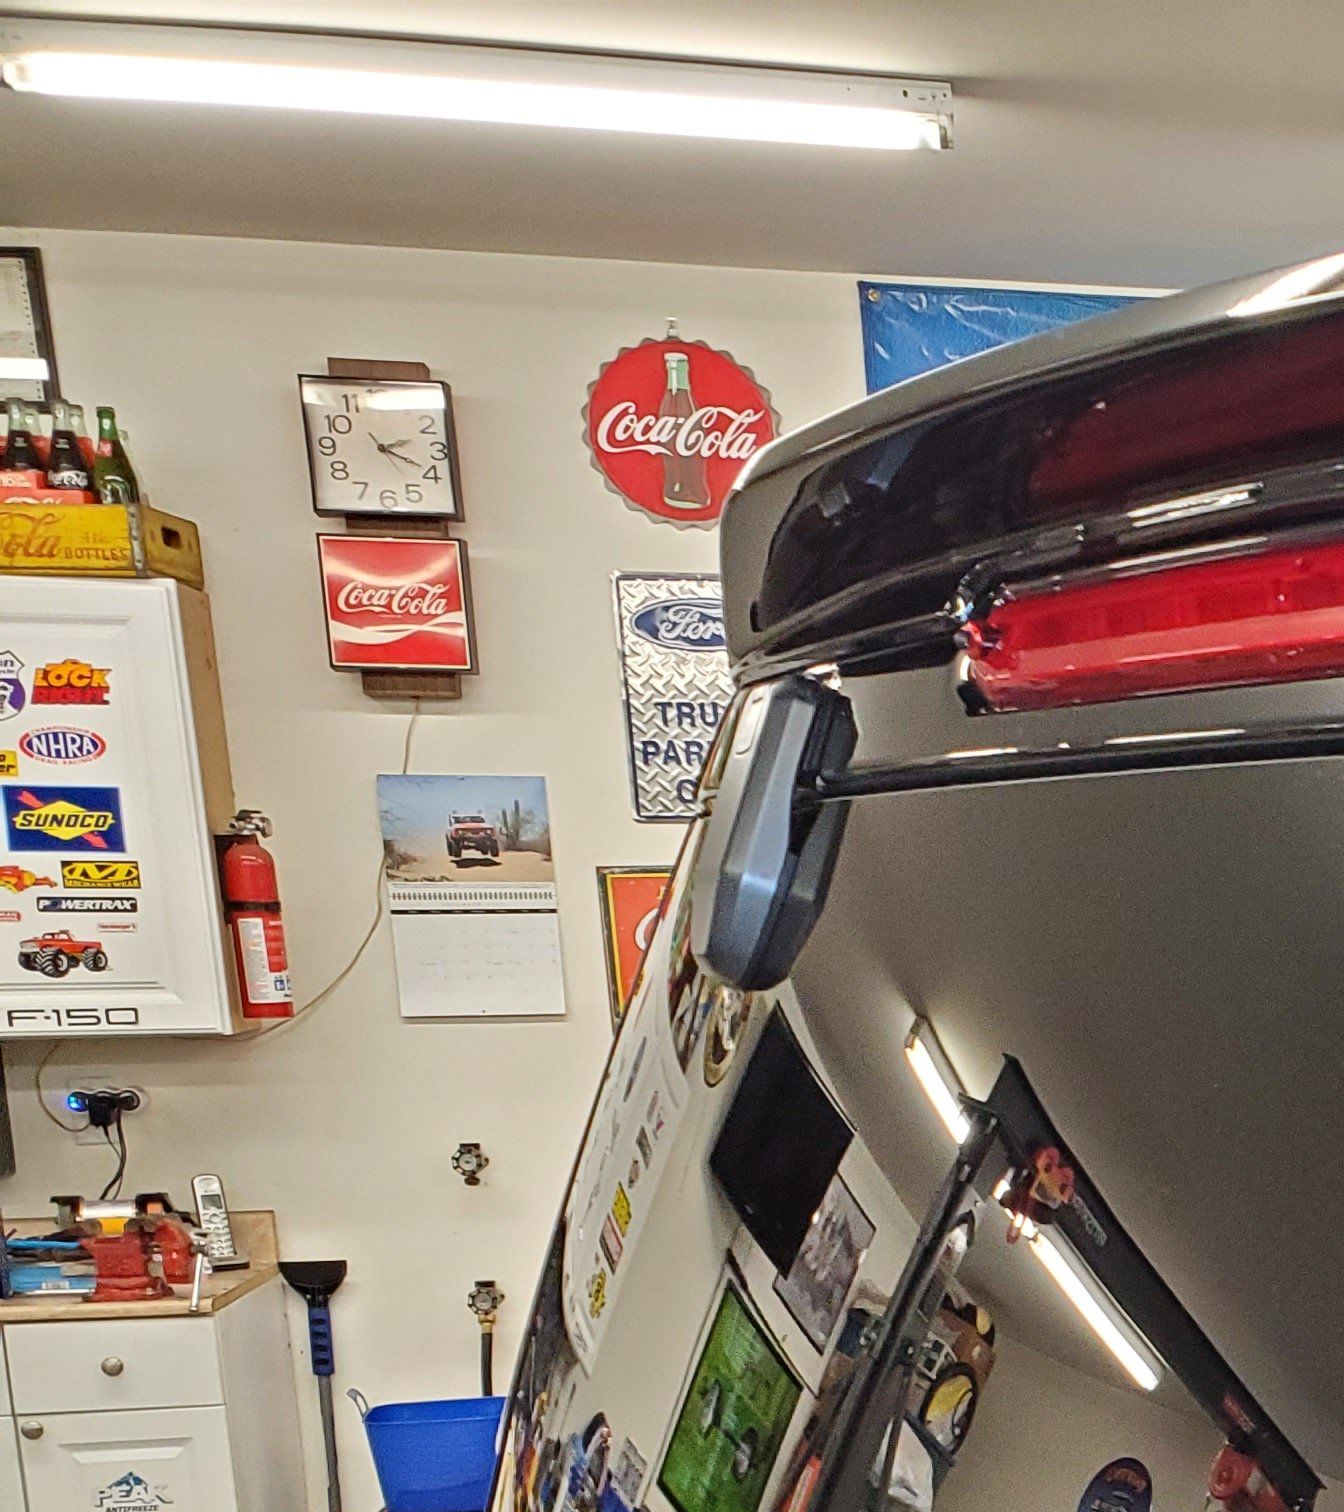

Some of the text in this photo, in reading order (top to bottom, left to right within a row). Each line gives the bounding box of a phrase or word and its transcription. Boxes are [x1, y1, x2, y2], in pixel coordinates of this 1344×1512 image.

[324, 414, 352, 434] 10
[418, 415, 437, 435] 2
[597, 401, 766, 460] Coca-Cola
[318, 436, 336, 456] 9
[429, 441, 448, 461] 3
[330, 461, 350, 480] 8
[422, 465, 443, 484] 4
[352, 481, 369, 500] 7
[379, 489, 399, 509] 6
[405, 484, 424, 503] 5
[337, 581, 450, 615] Coca-Cola
[658, 604, 726, 644] For
[31, 733, 96, 758] NHRA
[18, 813, 109, 829] SUNOCO
[7, 1007, 139, 1028] F-150
[94, 1483, 174, 1507] PEAK
[106, 1505, 159, 1512] ANTIFREEZE
